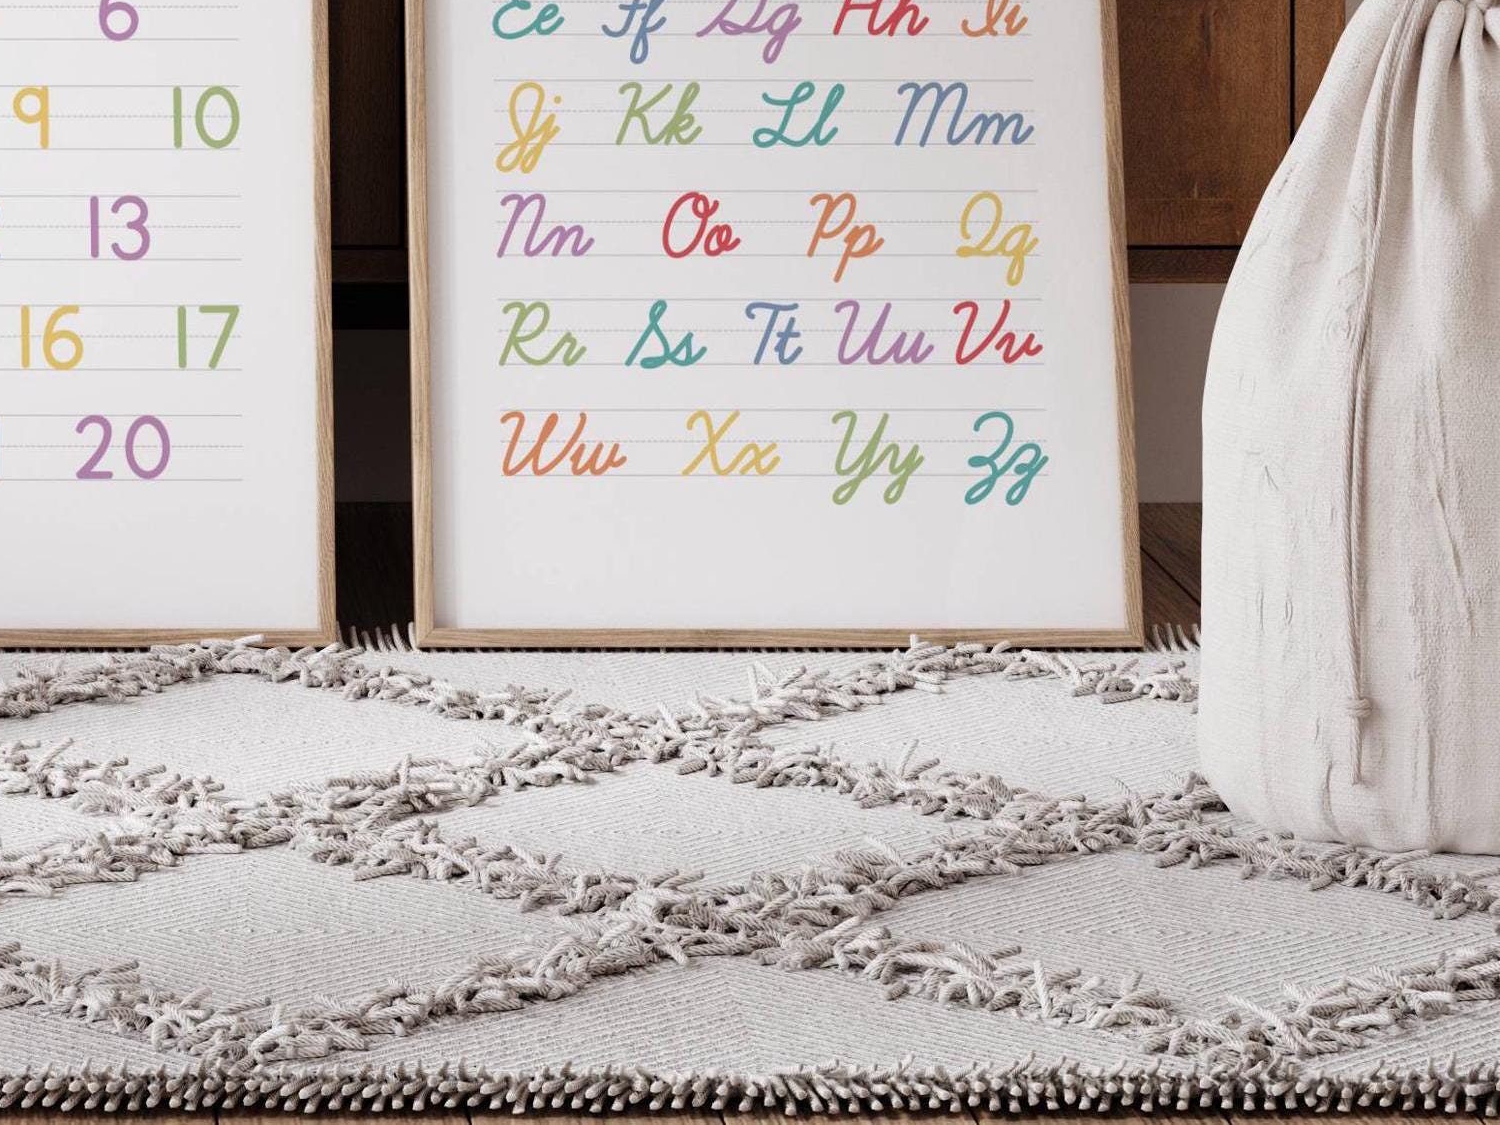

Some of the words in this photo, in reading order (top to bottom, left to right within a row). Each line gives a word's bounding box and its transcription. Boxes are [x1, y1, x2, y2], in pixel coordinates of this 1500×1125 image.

[11, 84, 51, 151] 9
[172, 85, 240, 150] 10
[494, 79, 564, 176] Jj
[616, 81, 703, 146] Kk
[751, 80, 846, 149] Ll
[894, 81, 1033, 147] Mm
[89, 193, 150, 261] 13
[497, 192, 594, 257] Nn
[660, 189, 742, 262] Oo
[805, 190, 885, 284] Pp
[954, 189, 1041, 289] Qq
[19, 303, 85, 372] 16
[177, 304, 241, 369] 17
[499, 301, 587, 367] Rr
[624, 298, 708, 370] Ss
[745, 301, 802, 365] Tt
[835, 298, 935, 366] Uu
[951, 296, 1045, 367] Vv
[76, 414, 171, 481] 20
[499, 409, 629, 479] Ww
[679, 408, 783, 479] Xx
[831, 410, 924, 506] Yy
[963, 410, 1049, 507] Zz
